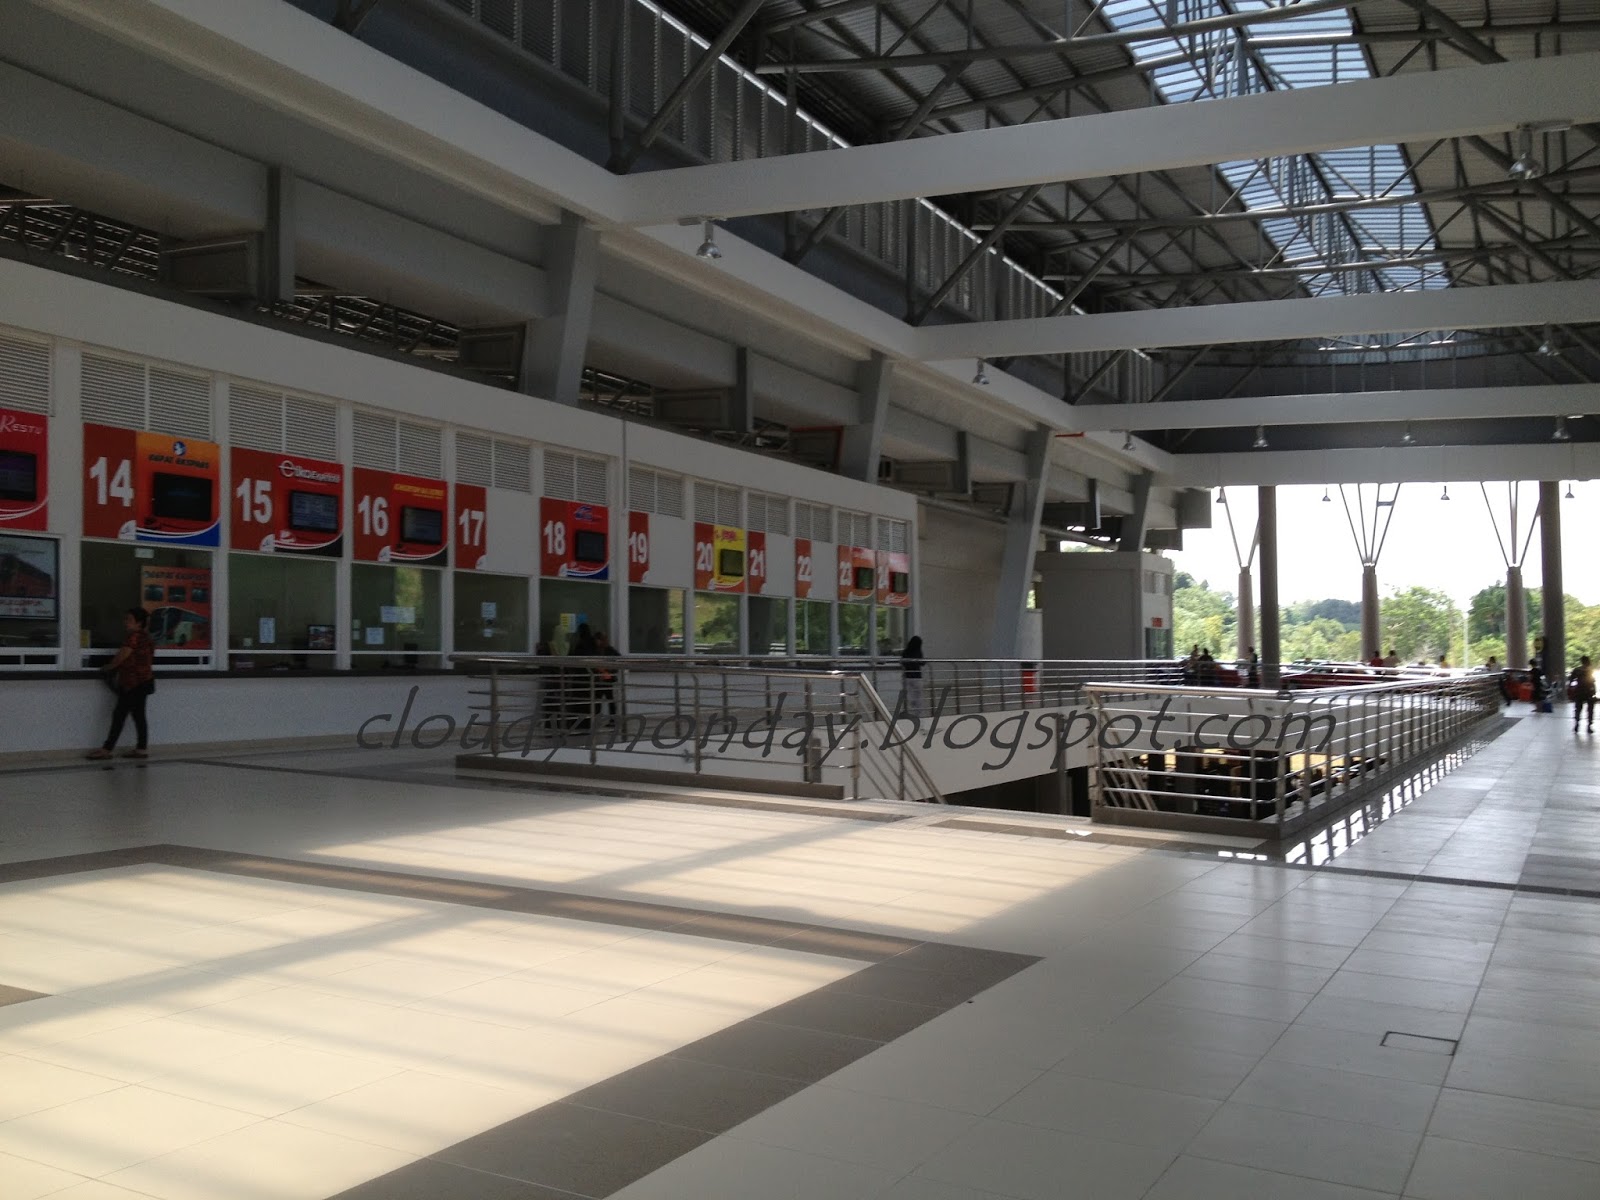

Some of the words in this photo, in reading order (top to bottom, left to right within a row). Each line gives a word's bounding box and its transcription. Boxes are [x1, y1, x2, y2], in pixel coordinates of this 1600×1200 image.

[90, 456, 134, 507] 14
[236, 478, 273, 523] 15
[358, 495, 389, 536] 16
[459, 508, 485, 546] 17
[544, 520, 565, 555] 18
[629, 531, 648, 564] 19
[696, 541, 713, 572] 20
[750, 548, 764, 577] 21
[797, 555, 812, 582] 22
[839, 561, 851, 586] 23
